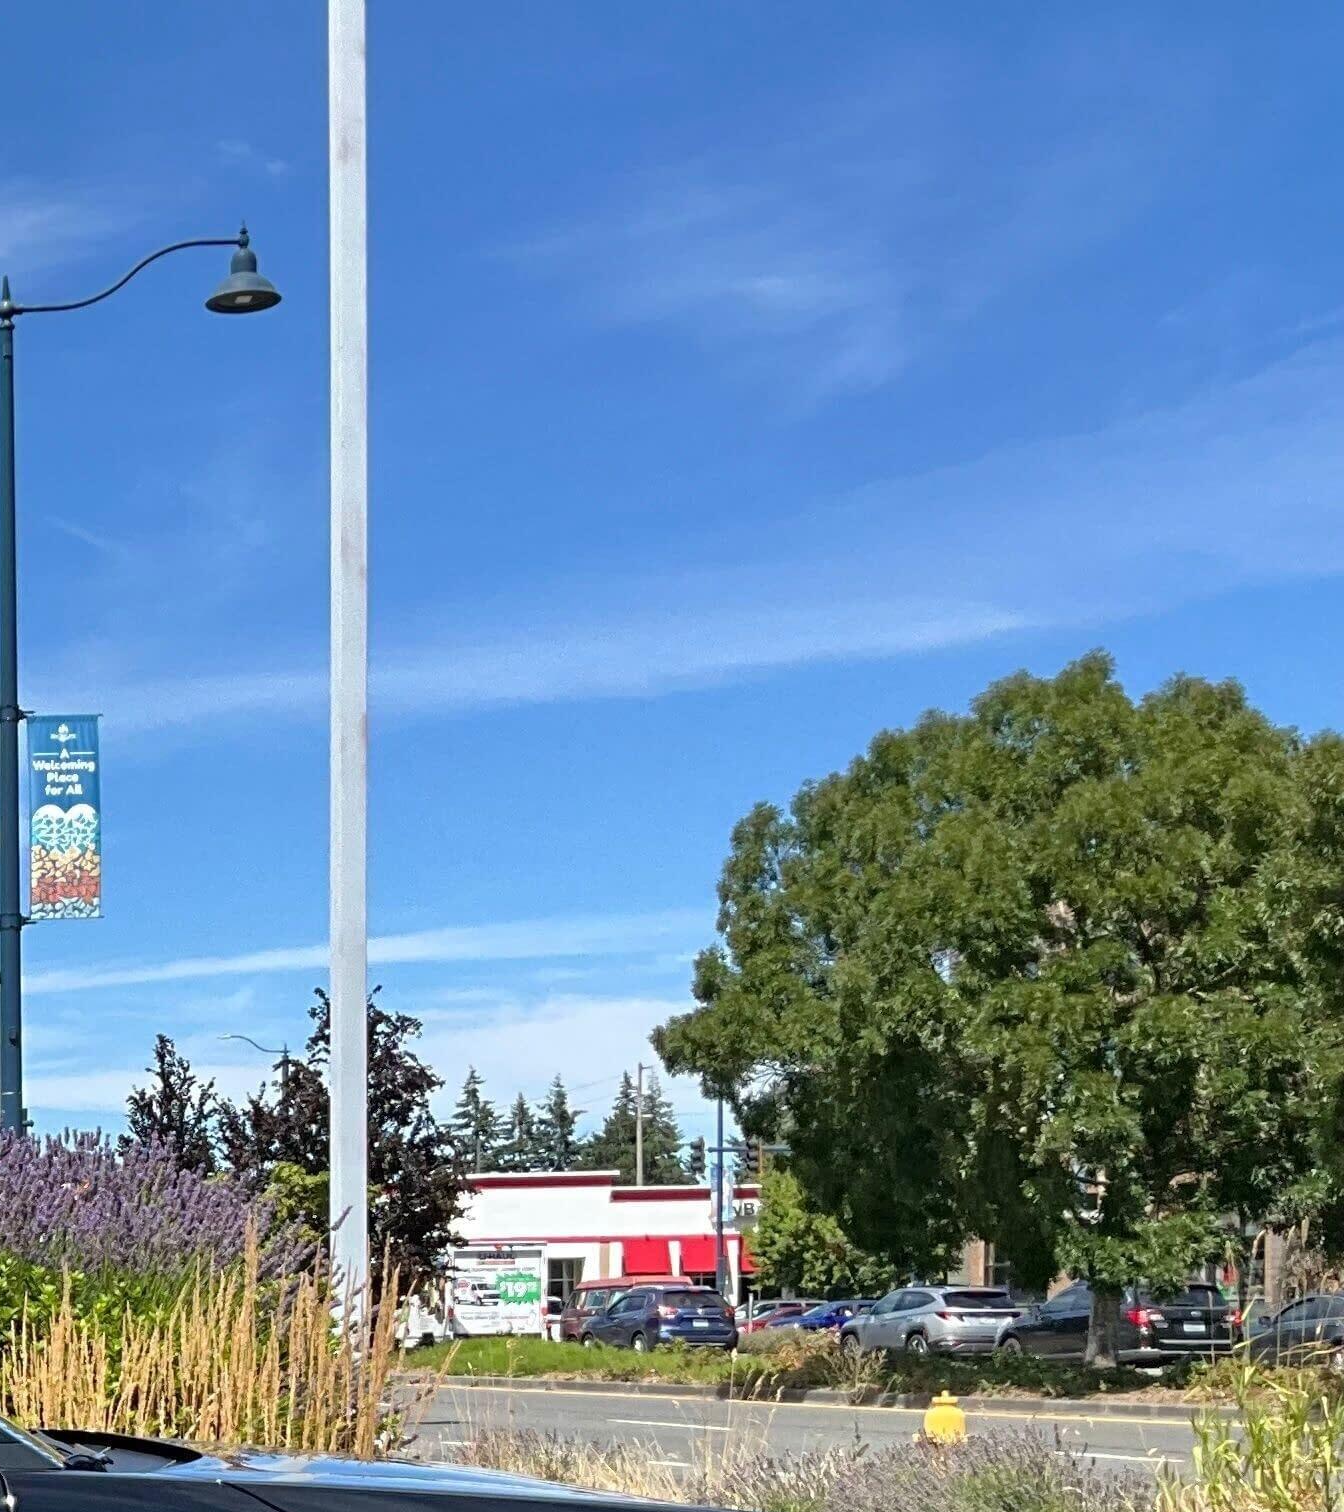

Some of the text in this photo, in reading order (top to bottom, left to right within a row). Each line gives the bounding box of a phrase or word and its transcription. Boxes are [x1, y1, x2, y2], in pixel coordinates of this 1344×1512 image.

[59, 748, 70, 759] A
[32, 759, 95, 772] Welcoming
[46, 772, 79, 783] Place
[44, 783, 83, 796] for All
